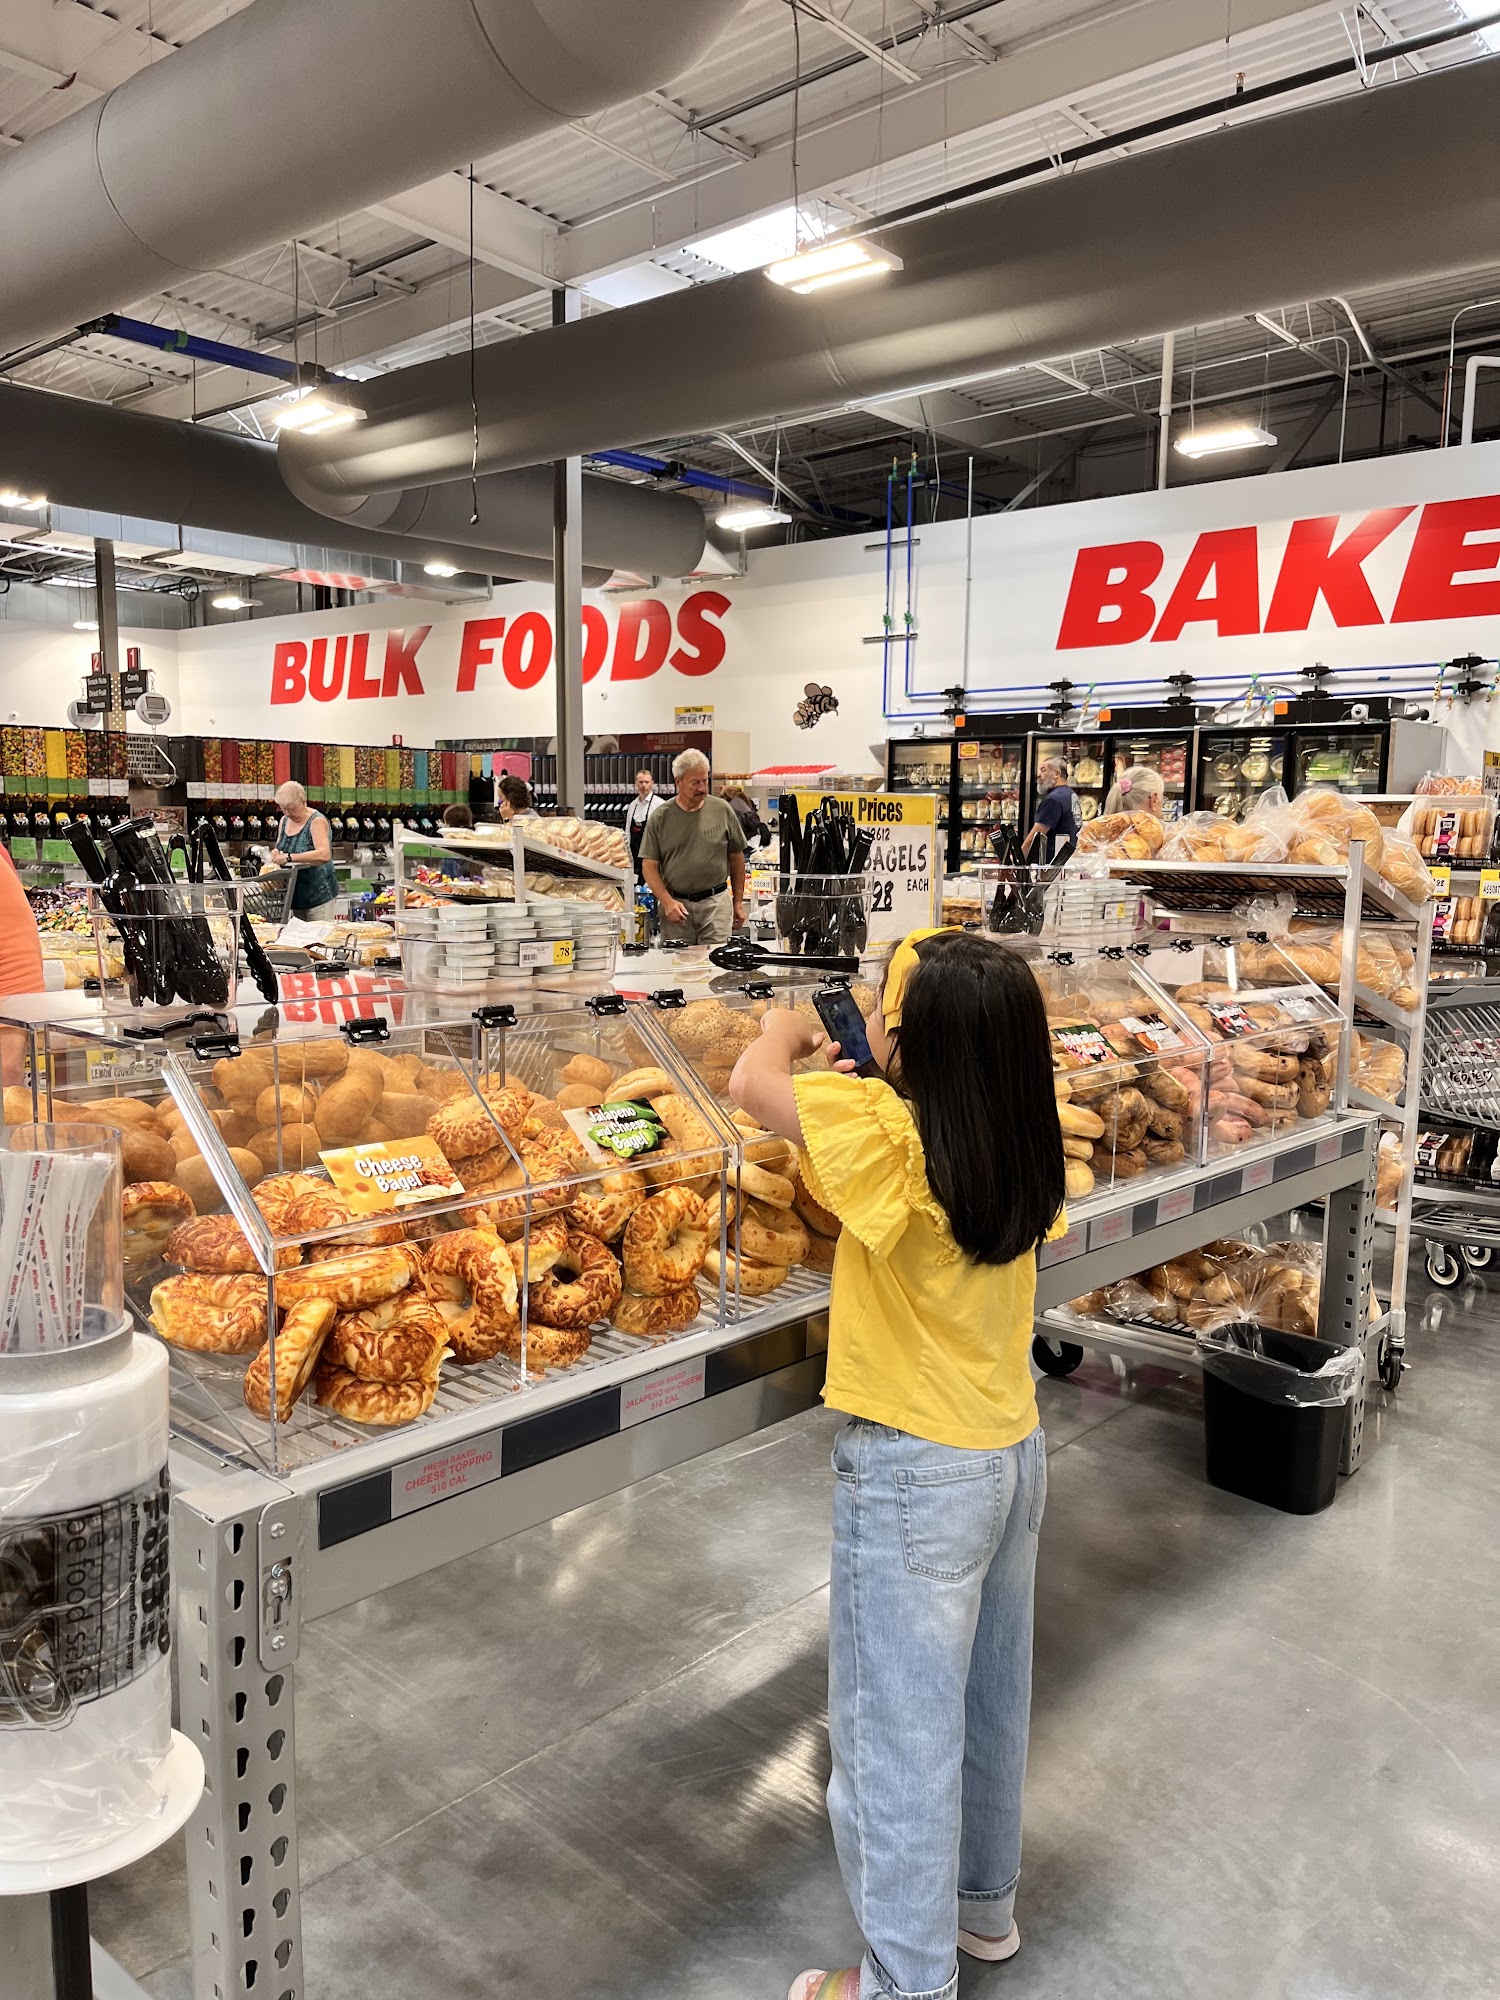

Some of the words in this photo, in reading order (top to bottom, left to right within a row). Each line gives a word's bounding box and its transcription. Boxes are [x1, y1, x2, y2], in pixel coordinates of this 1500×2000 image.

[1056, 494, 1500, 650] BAKE
[270, 625, 433, 705] BULK
[456, 591, 732, 692] FOODS
[93, 653, 100, 671] 2
[130, 649, 135, 668] 1
[394, 736, 400, 746] 9
[858, 798, 903, 822] Prices
[907, 878, 929, 892] EACH
[557, 947, 570, 957] .78
[91, 1068, 112, 1080] LEMON
[588, 1107, 636, 1123] Jalapeno
[595, 1126, 612, 1137] and
[610, 1119, 648, 1134] Cheese
[611, 1131, 648, 1150] Bagel
[32, 1160, 40, 1182] WinCo
[354, 1154, 422, 1178] Cheese
[28, 1184, 36, 1199] BIN#
[375, 1171, 423, 1193] Bagel
[22, 1217, 30, 1239] WinCo
[10, 1275, 19, 1296] WinCo
[644, 1380, 664, 1391] FRESH
[665, 1371, 686, 1384] BAKED
[677, 1372, 703, 1389] CHEESE
[650, 1400, 663, 1410] 310
[665, 1394, 679, 1405] CAL
[423, 1458, 448, 1473] FRESH
[451, 1448, 476, 1464] BAKED
[405, 1469, 447, 1491] CHEESE
[450, 1451, 493, 1474] TOPPING
[431, 1482, 447, 1494] 310
[449, 1474, 468, 1487] CAL
[130, 1502, 139, 1519] An
[129, 1520, 140, 1567] Employee
[66, 1559, 94, 1624] food
